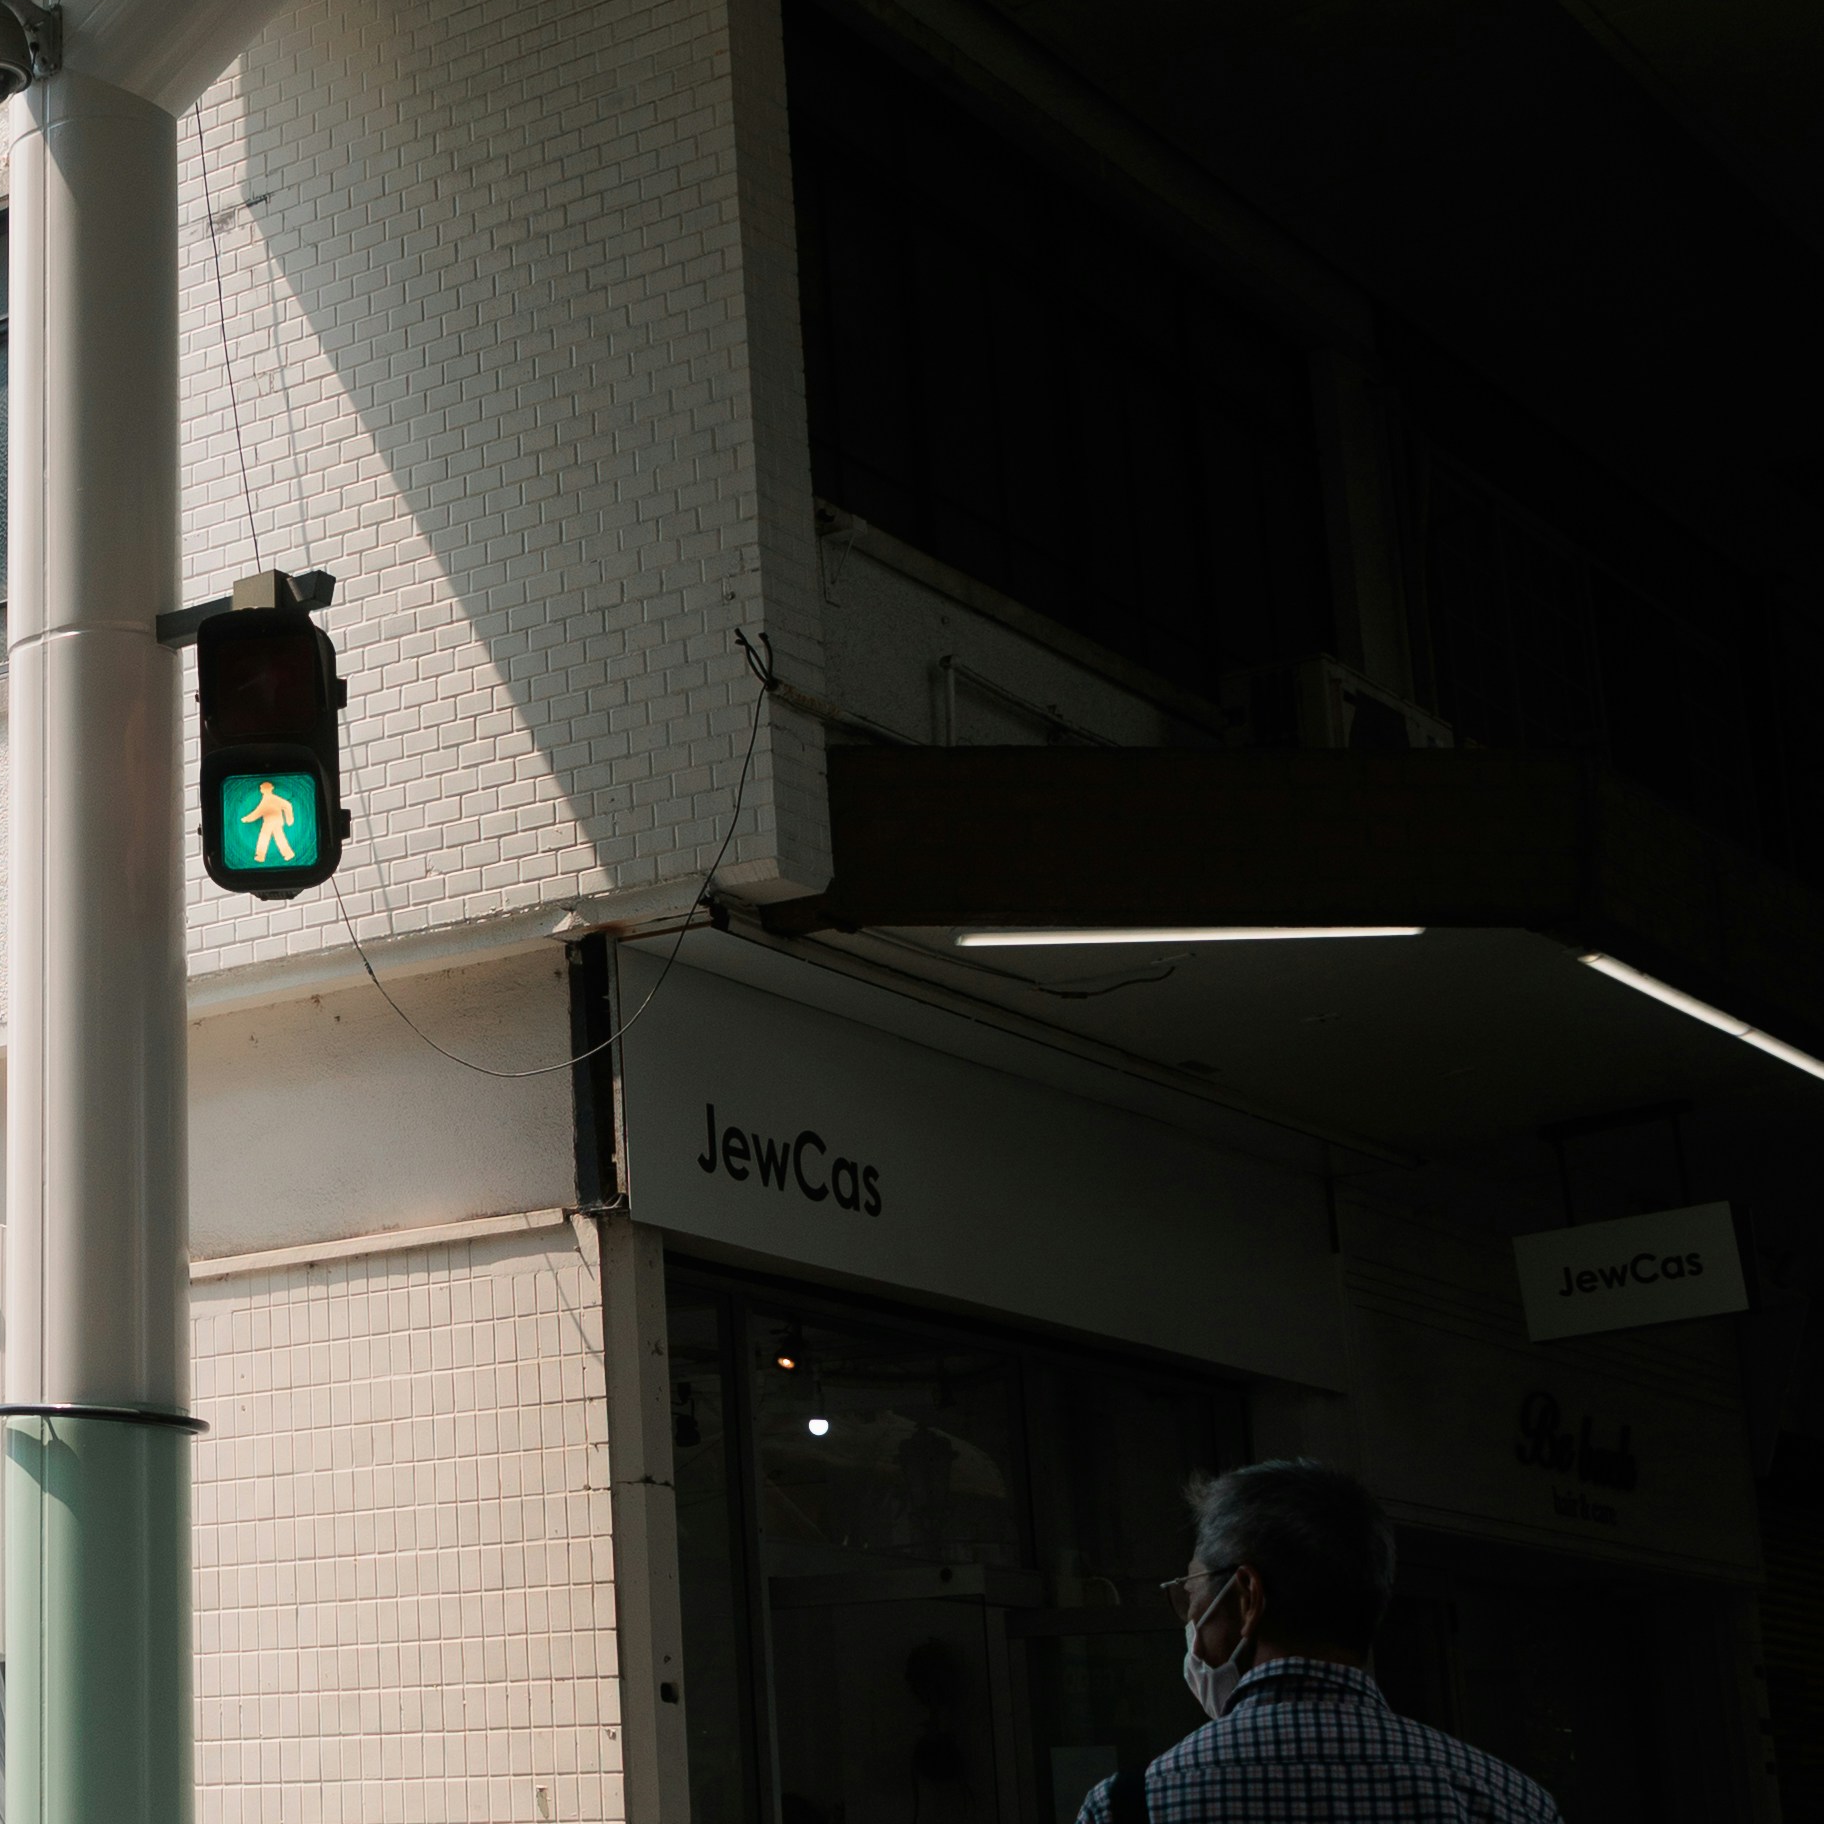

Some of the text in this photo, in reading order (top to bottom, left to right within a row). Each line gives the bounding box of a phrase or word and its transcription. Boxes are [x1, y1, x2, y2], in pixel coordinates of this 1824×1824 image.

[697, 1102, 882, 1218] JewCas
[1558, 1251, 1704, 1297] JewCas
[1551, 1484, 1579, 1519] hair
